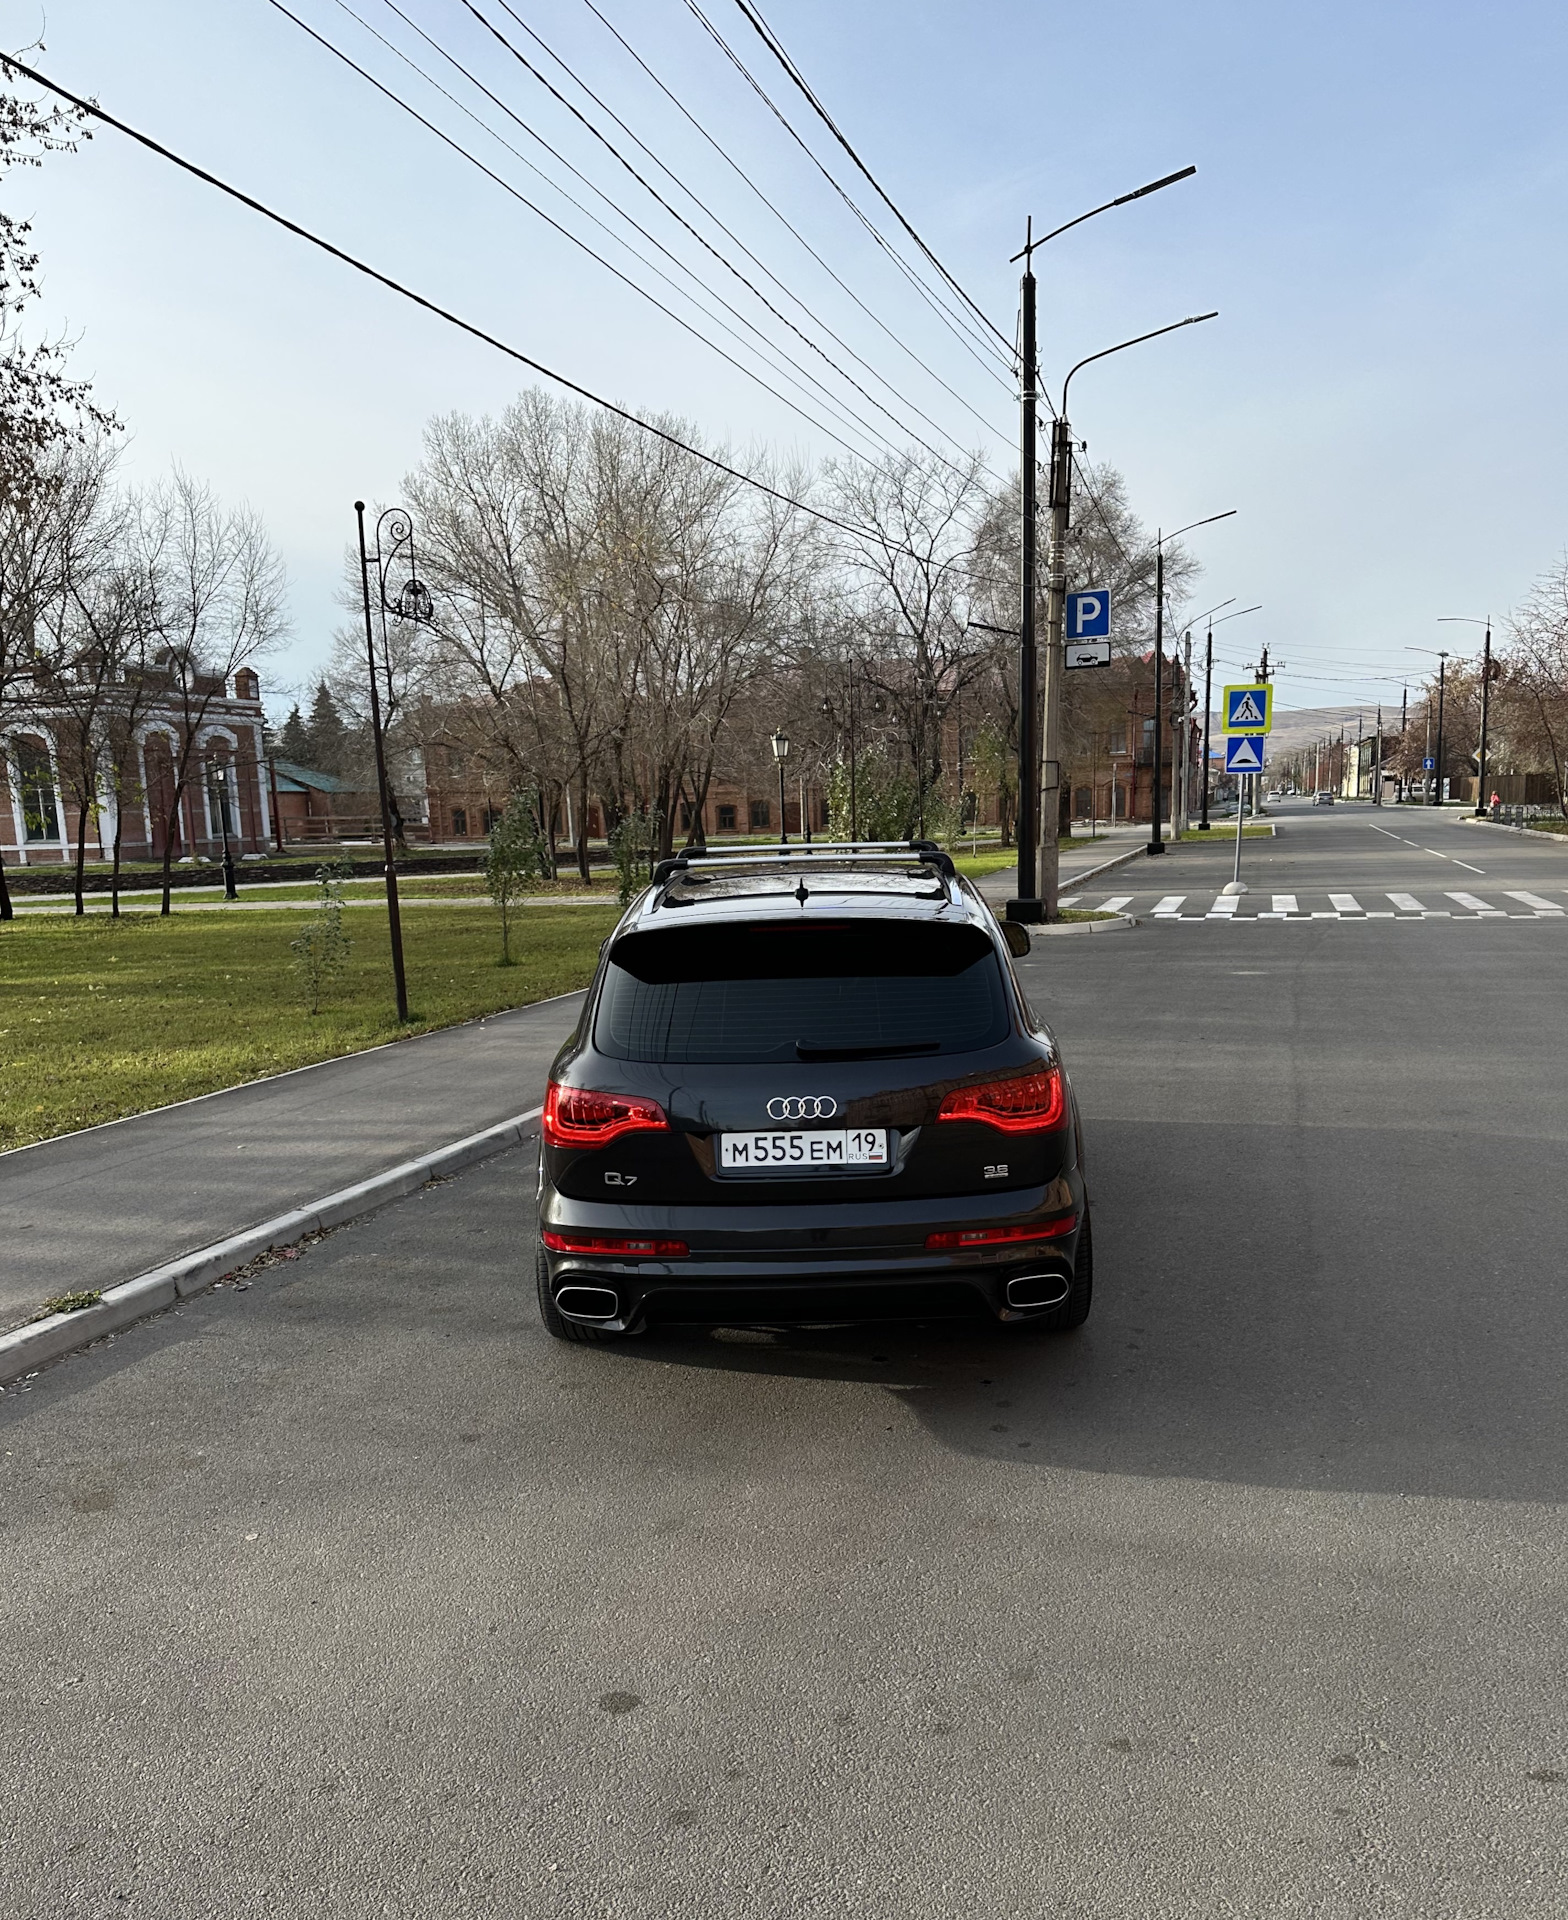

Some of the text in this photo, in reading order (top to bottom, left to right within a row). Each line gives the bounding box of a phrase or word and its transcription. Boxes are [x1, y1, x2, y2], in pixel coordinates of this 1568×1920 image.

[1076, 596, 1102, 633] P
[851, 1132, 876, 1152] 19
[848, 1153, 868, 1161] RUS
[604, 1171, 638, 1186] Q7
